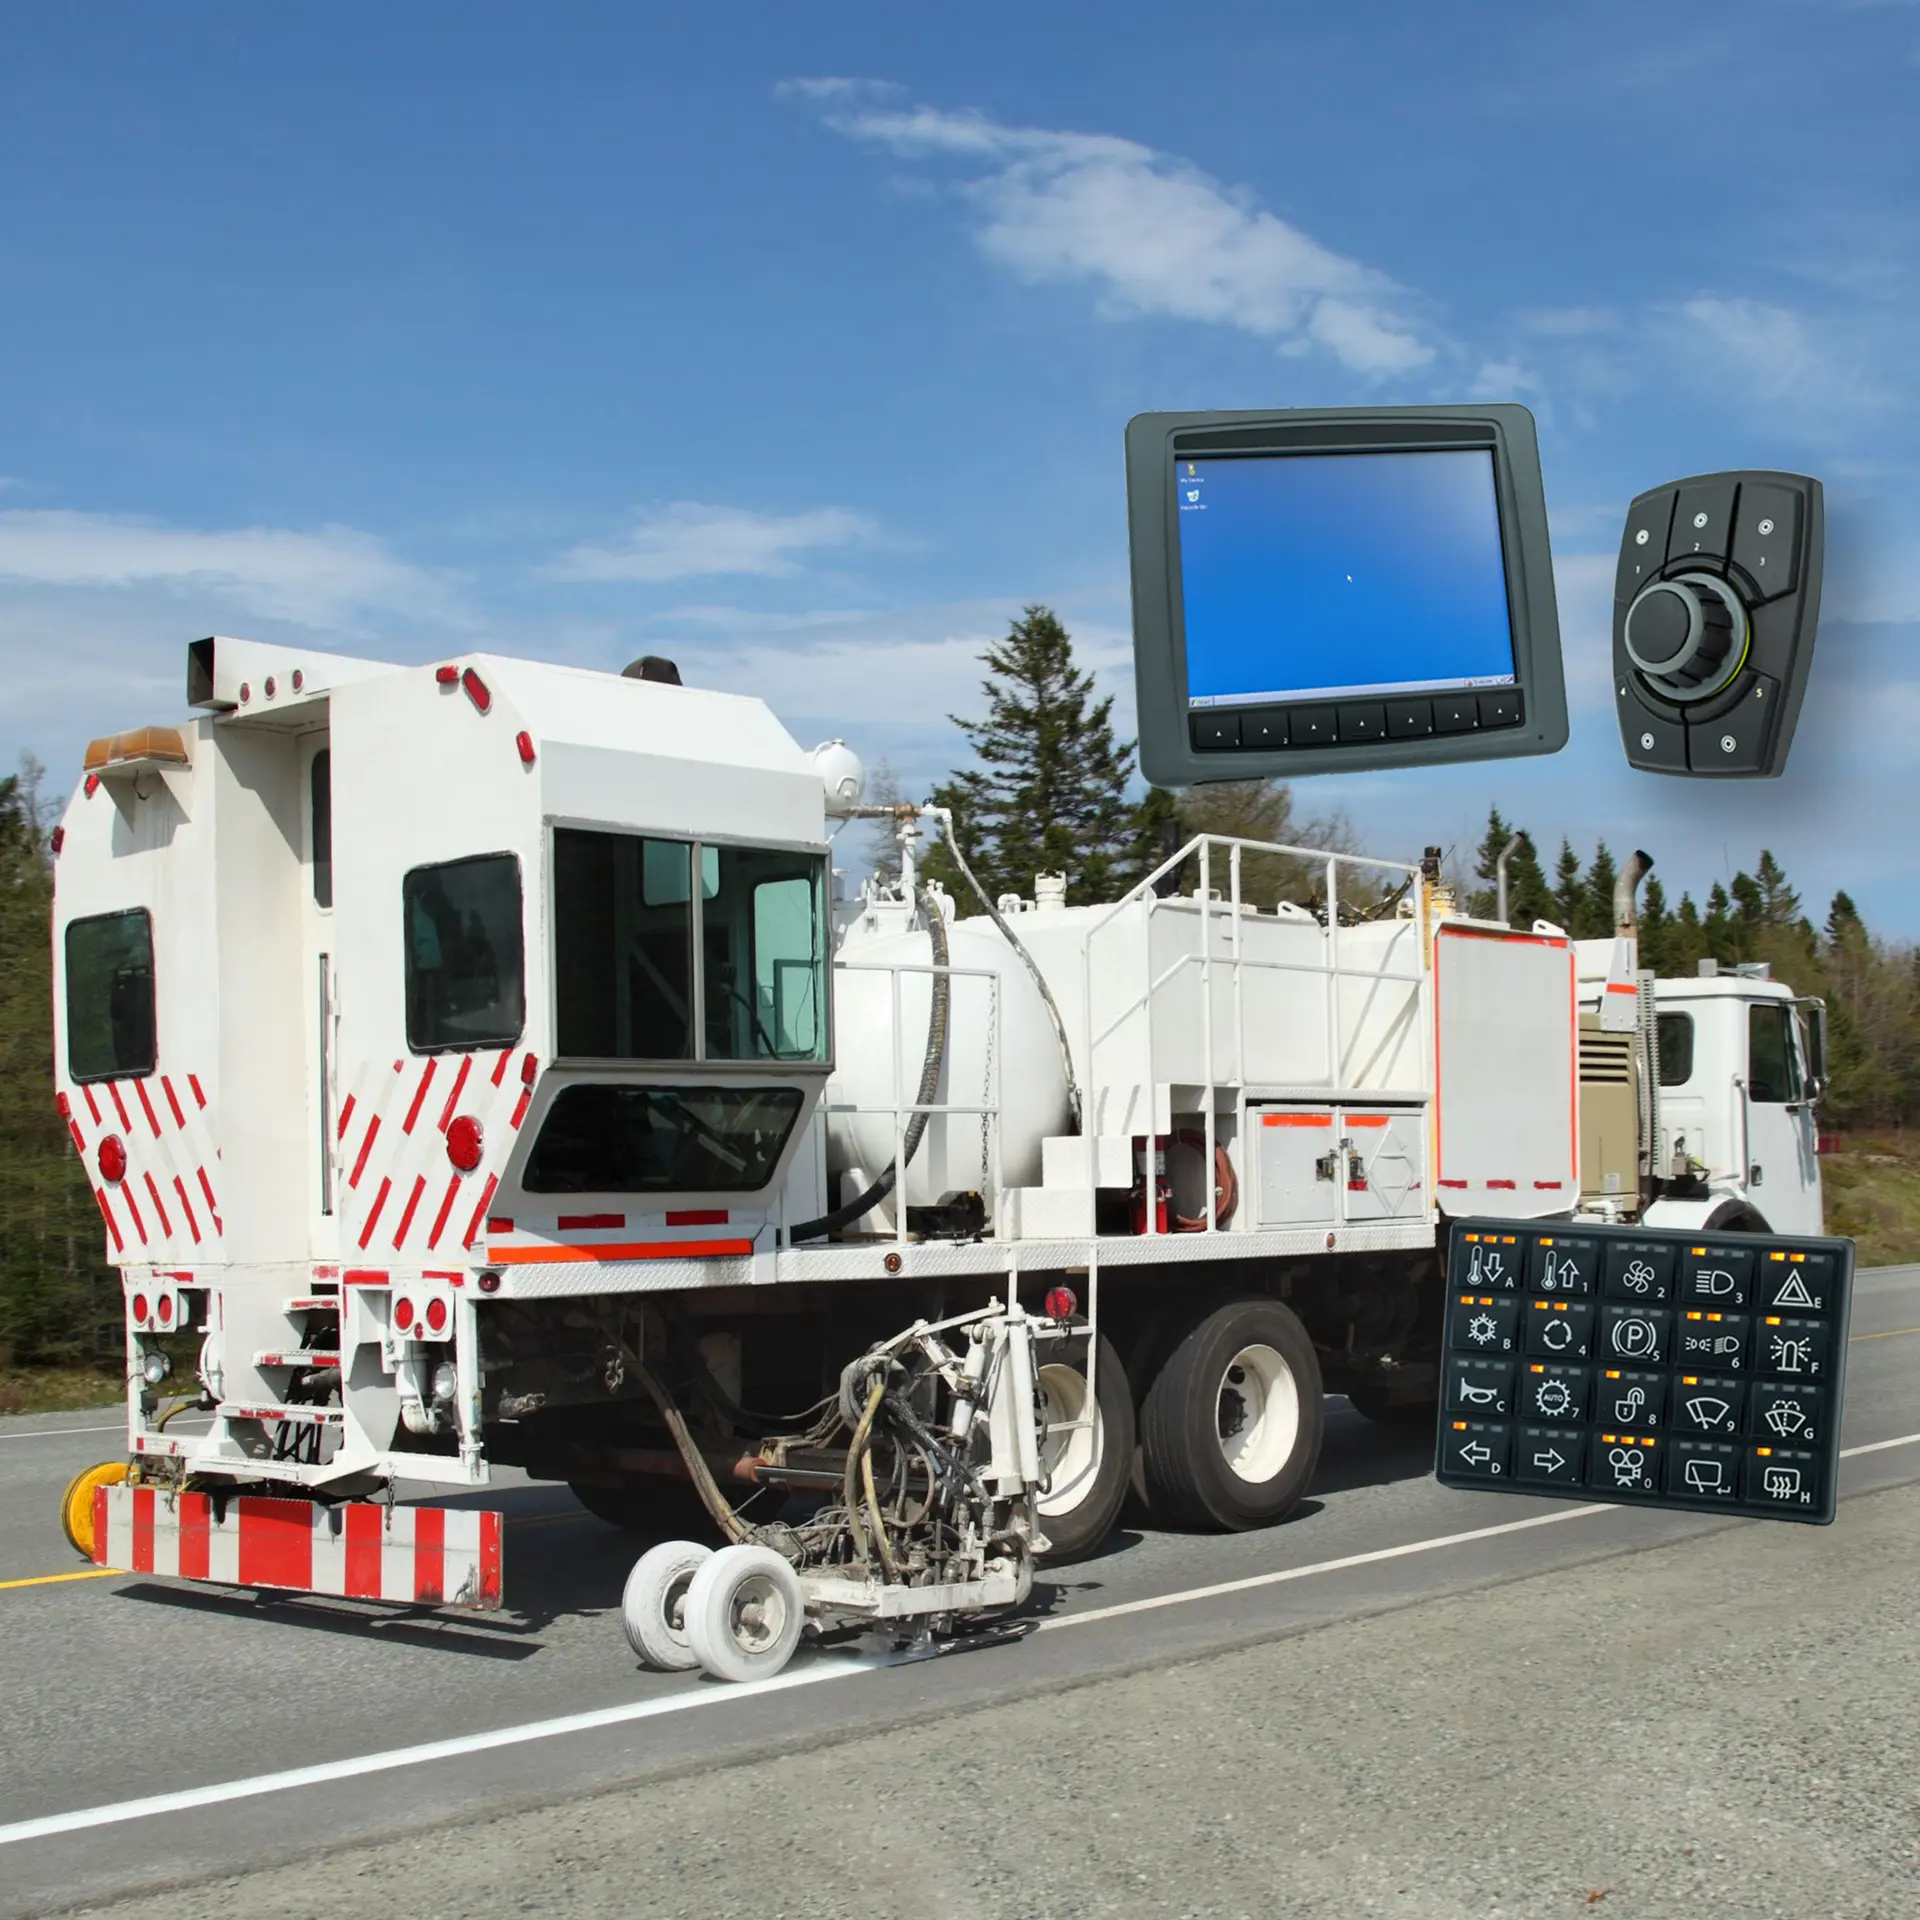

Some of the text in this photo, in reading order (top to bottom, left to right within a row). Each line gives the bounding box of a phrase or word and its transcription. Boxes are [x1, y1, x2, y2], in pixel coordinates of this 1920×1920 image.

[1505, 1277, 1513, 1287] A
[1582, 1282, 1588, 1292] 1
[1658, 1287, 1664, 1297] 2
[1736, 1292, 1743, 1303] 3
[1813, 1297, 1821, 1308] E
[1627, 1326, 1643, 1349] P
[1503, 1338, 1511, 1349] B
[1579, 1345, 1586, 1355] 4
[1652, 1350, 1660, 1361] 5
[1732, 1357, 1739, 1368] 6
[1811, 1362, 1818, 1373] F
[1543, 1393, 1564, 1403] AUTO
[1497, 1401, 1504, 1411] C
[1573, 1408, 1579, 1417] 7
[1649, 1414, 1656, 1425] 8
[1727, 1421, 1735, 1431] 9
[1804, 1428, 1813, 1439] G
[1492, 1463, 1501, 1473] D
[1644, 1478, 1652, 1488] 0
[1801, 1492, 1810, 1503] H
